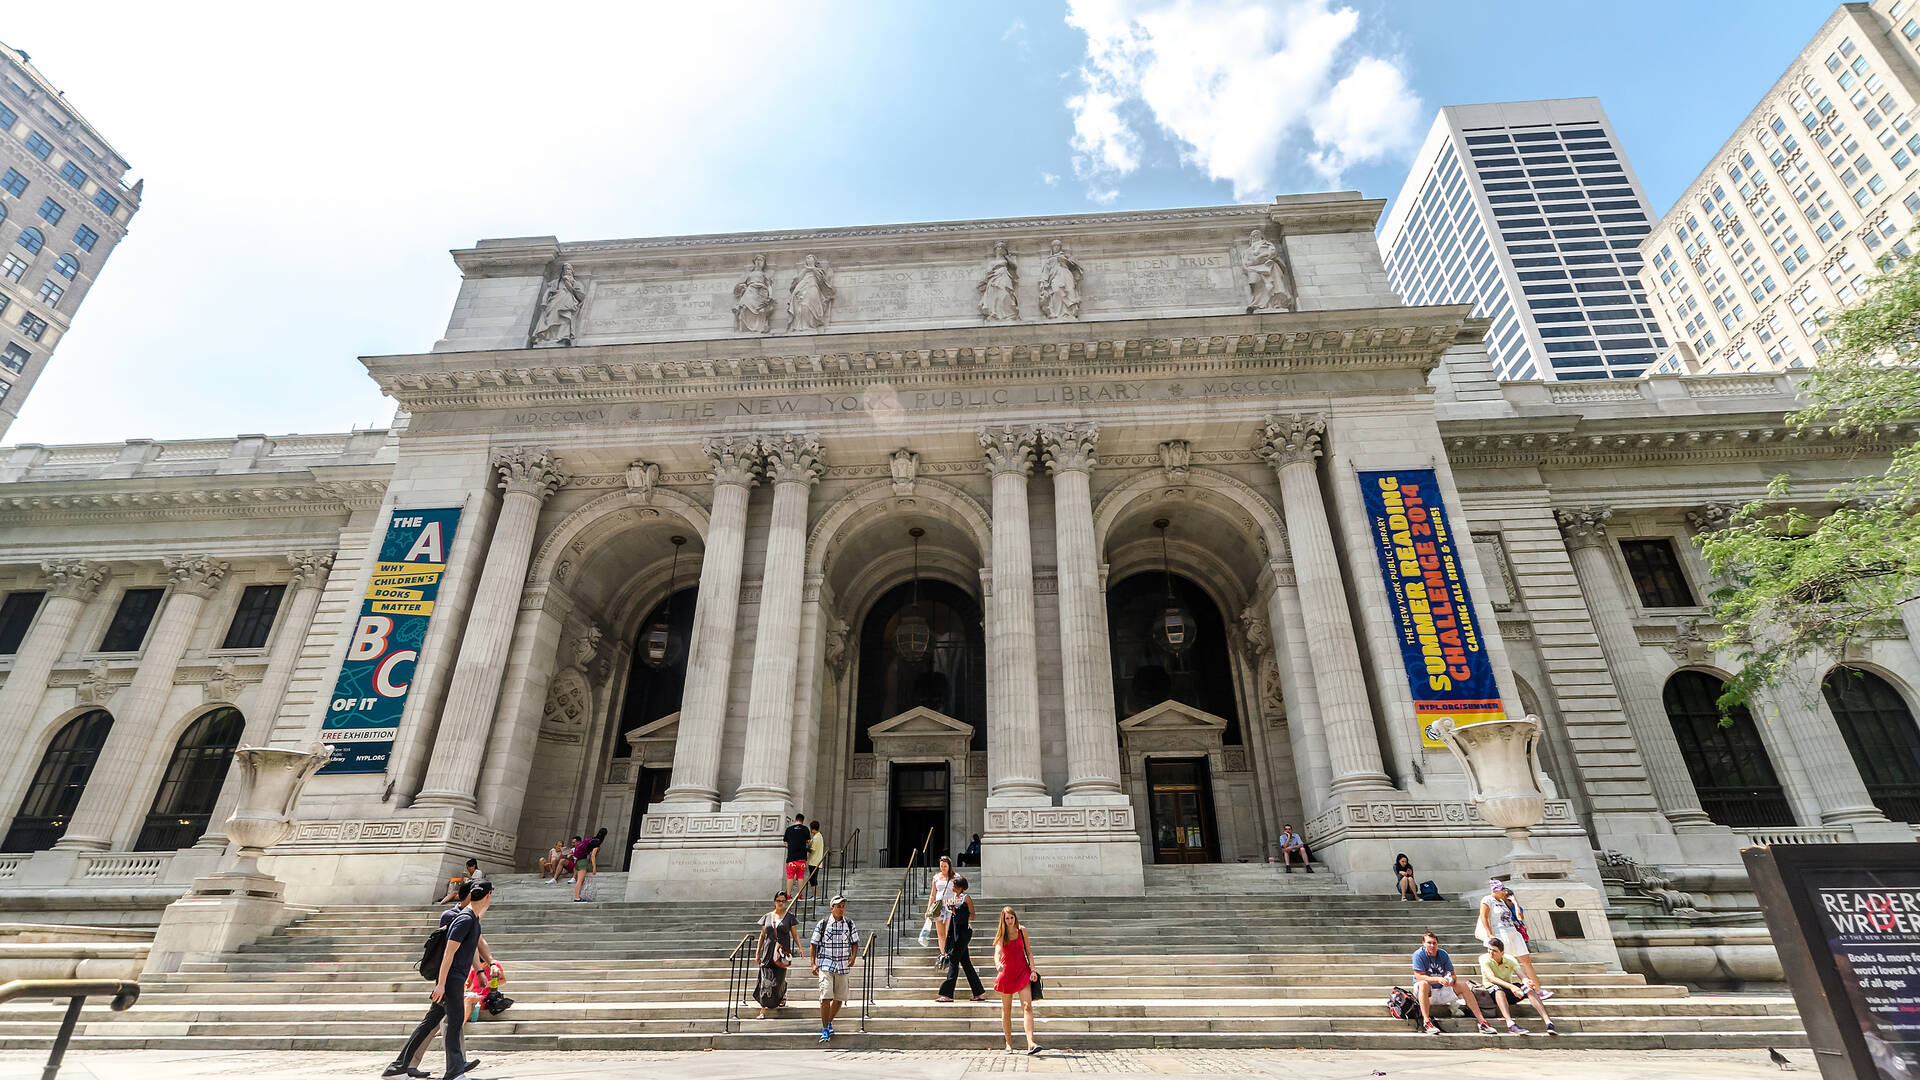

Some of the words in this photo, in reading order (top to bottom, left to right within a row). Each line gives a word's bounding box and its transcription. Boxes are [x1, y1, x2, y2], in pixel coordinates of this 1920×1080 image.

[1181, 256, 1222, 267] TRUST
[513, 409, 607, 425] MDCCCXCV
[664, 401, 716, 420] THE
[736, 399, 800, 416] NEW
[823, 395, 891, 413] YORK
[915, 388, 1009, 409] PUBLIC
[1034, 383, 1146, 403] LIBRARY
[1203, 378, 1298, 395] MDCCCCII
[1400, 484, 1431, 536] 2014
[393, 516, 424, 529] THE
[1376, 516, 1392, 549] LIBRARY
[1378, 477, 1421, 577] READING
[1429, 507, 1447, 543] TEENS!
[404, 521, 444, 562] A
[1441, 544, 1450, 553] &
[380, 564, 405, 572] WHY
[1384, 550, 1399, 580] PUBLIC
[1443, 555, 1458, 581] KIDS
[374, 575, 434, 586] CHILDREN'S
[375, 589, 411, 599] BOOKS
[1392, 581, 1405, 606] YORK
[1451, 582, 1465, 603] ALL
[380, 603, 422, 611] MATTER
[1400, 605, 1411, 626] NEW
[1415, 541, 1471, 681] CHALLENGE
[347, 616, 394, 661] B
[1404, 627, 1416, 645] THE
[1405, 582, 1452, 691] SUMMER
[1457, 604, 1479, 652] CALLING
[372, 649, 417, 698] C
[332, 698, 357, 712] OF
[358, 697, 378, 711] IT
[321, 732, 342, 740] FREE
[343, 730, 394, 739] EXHIBITION
[356, 754, 386, 762] NYPL.ORG
[1847, 952, 1876, 963] Books
[1877, 953, 1887, 963] &
[1887, 954, 1912, 962] more
[1853, 966, 1879, 975] word
[1878, 966, 1908, 975] lovers
[1908, 965, 1918, 975] &
[1859, 978, 1870, 988] of
[1870, 978, 1883, 988] all
[1883, 979, 1907, 990] ages
